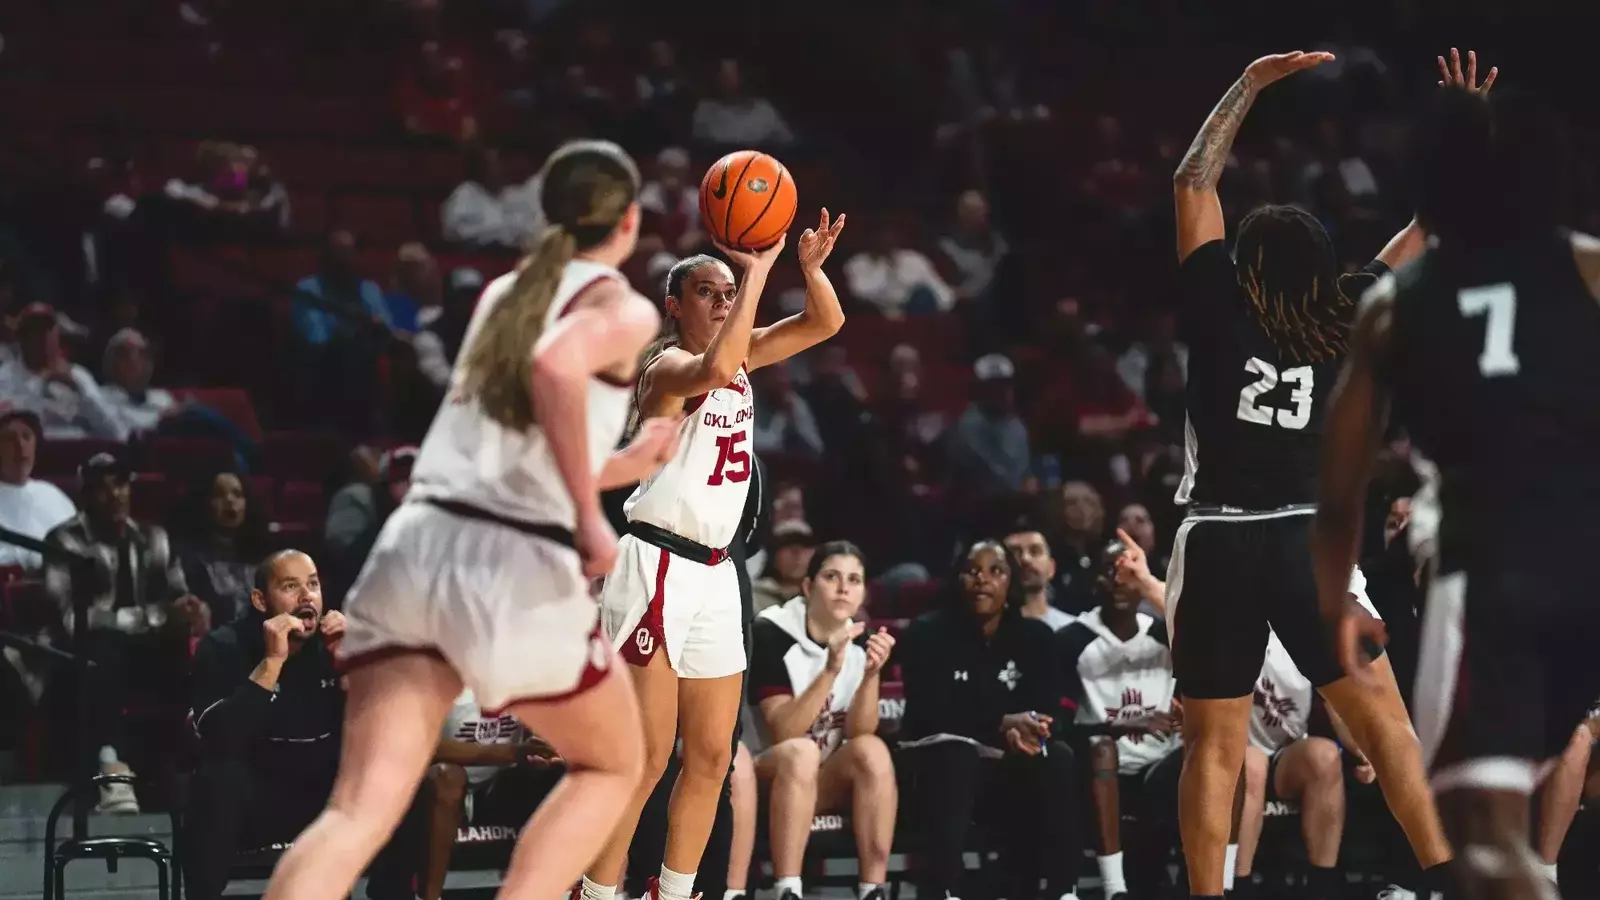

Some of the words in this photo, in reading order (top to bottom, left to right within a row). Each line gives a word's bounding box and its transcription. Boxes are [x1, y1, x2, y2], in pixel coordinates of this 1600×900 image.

[1456, 282, 1521, 379] 7
[704, 405, 754, 428] OKLOMA
[1236, 356, 1314, 430] 23
[707, 430, 751, 486] 15
[636, 628, 654, 655] OU
